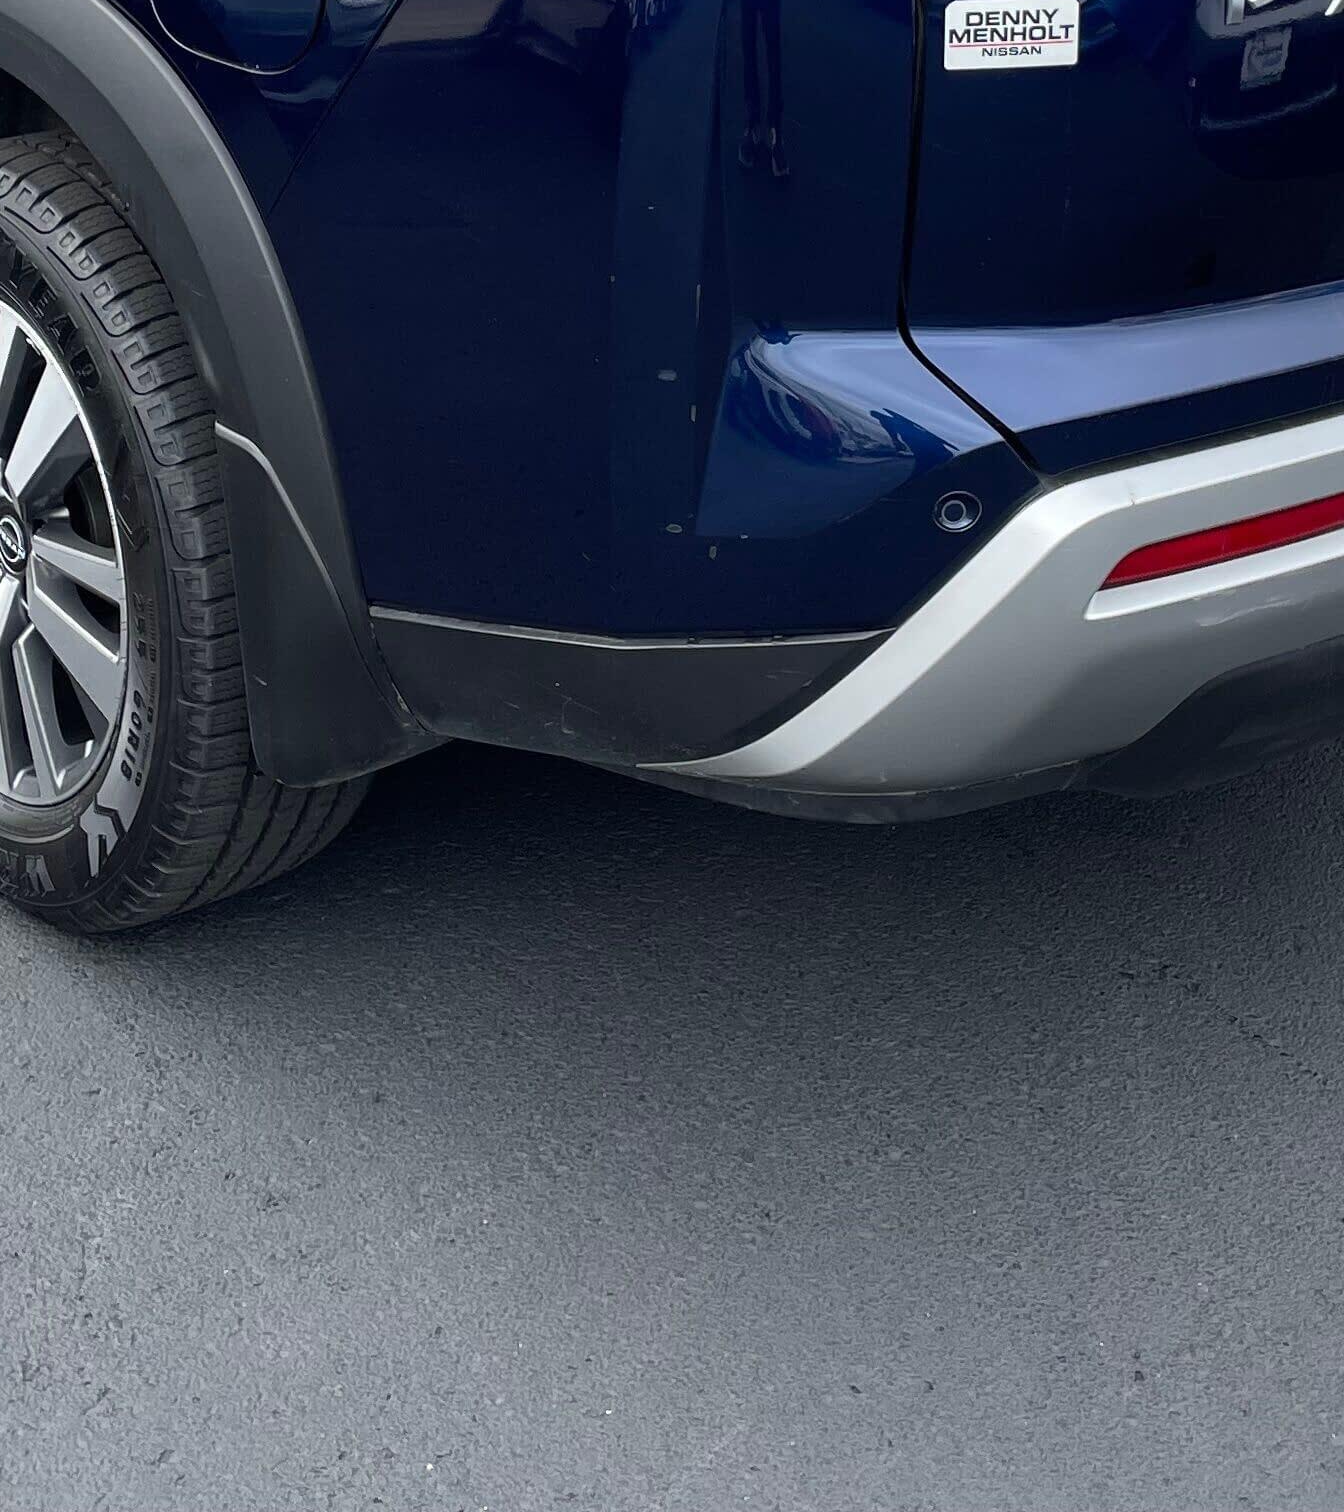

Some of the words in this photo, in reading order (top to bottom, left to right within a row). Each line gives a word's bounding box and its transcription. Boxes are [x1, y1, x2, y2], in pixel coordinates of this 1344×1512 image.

[965, 8, 1060, 27] DENNY
[948, 24, 1075, 44] MENHOLT
[981, 45, 1043, 57] NISSAN
